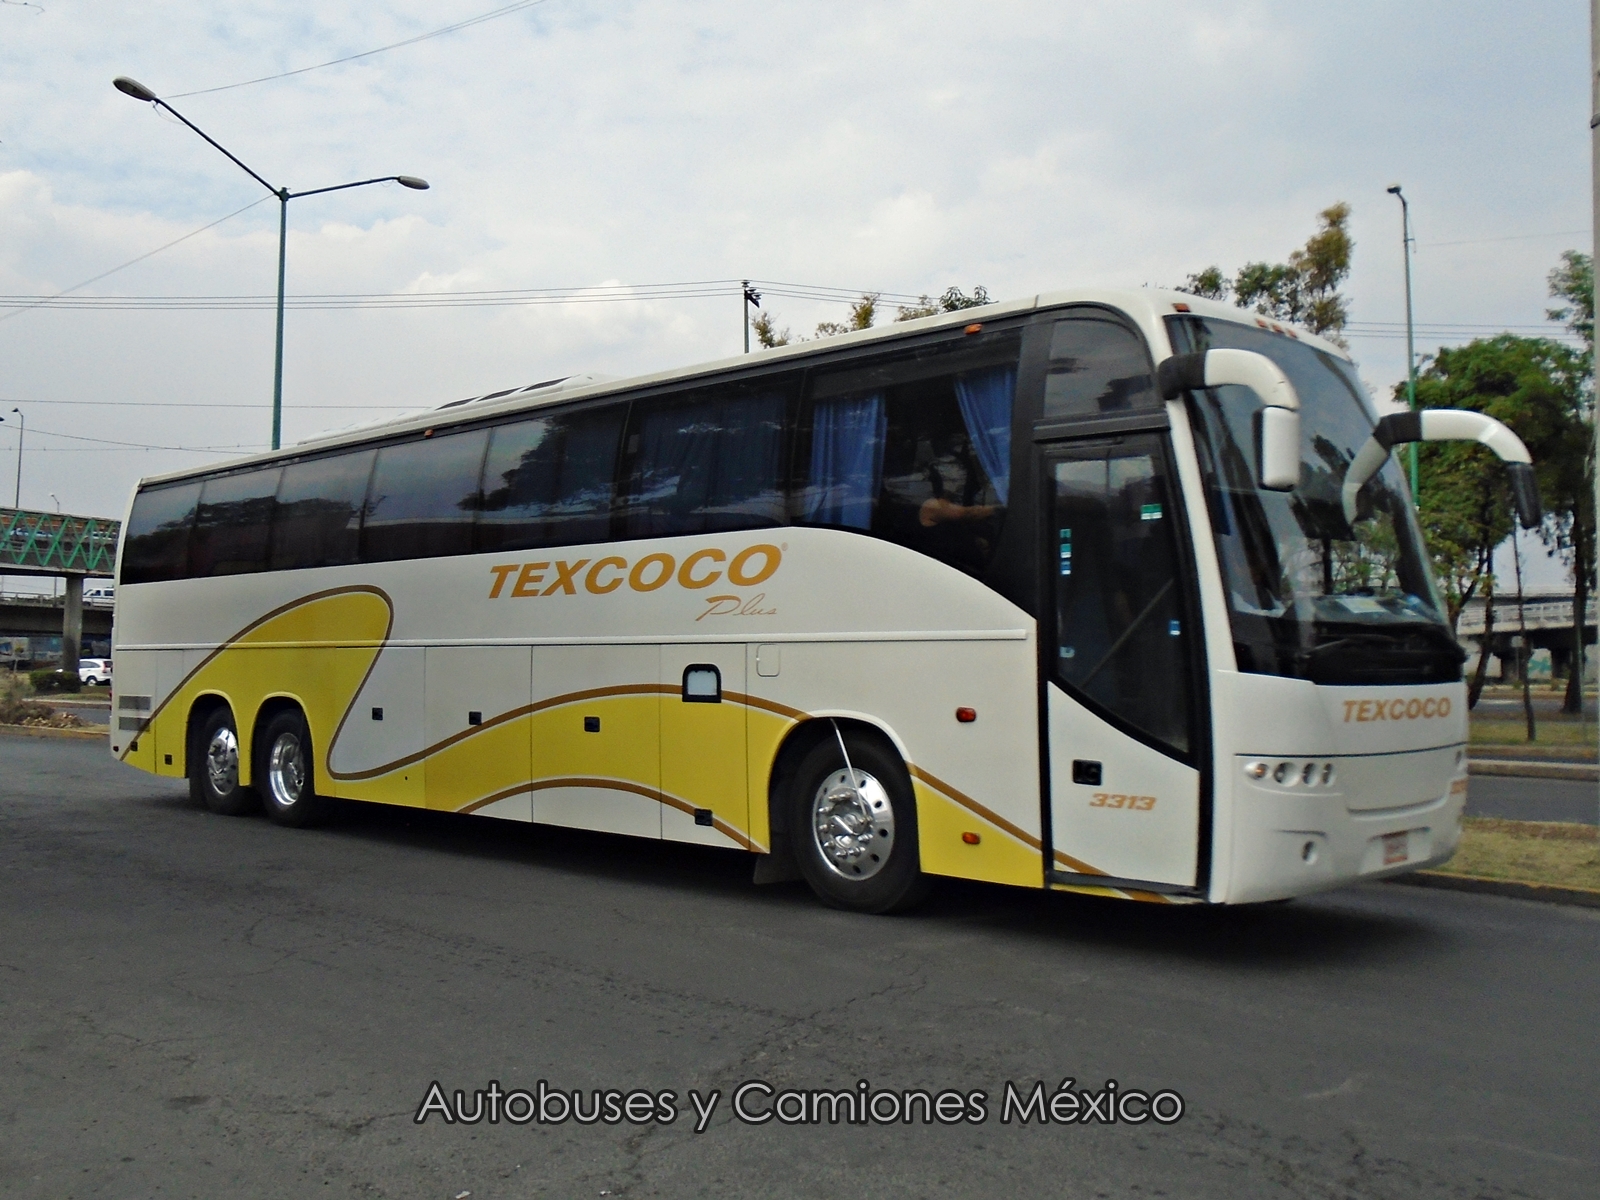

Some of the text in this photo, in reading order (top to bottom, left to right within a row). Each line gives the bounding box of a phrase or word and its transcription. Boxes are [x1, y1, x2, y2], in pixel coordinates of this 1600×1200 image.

[489, 543, 782, 599] TEXCOCO
[695, 593, 777, 621] Plus
[1342, 698, 1451, 723] TEXCOCO
[1089, 793, 1157, 811] 3313
